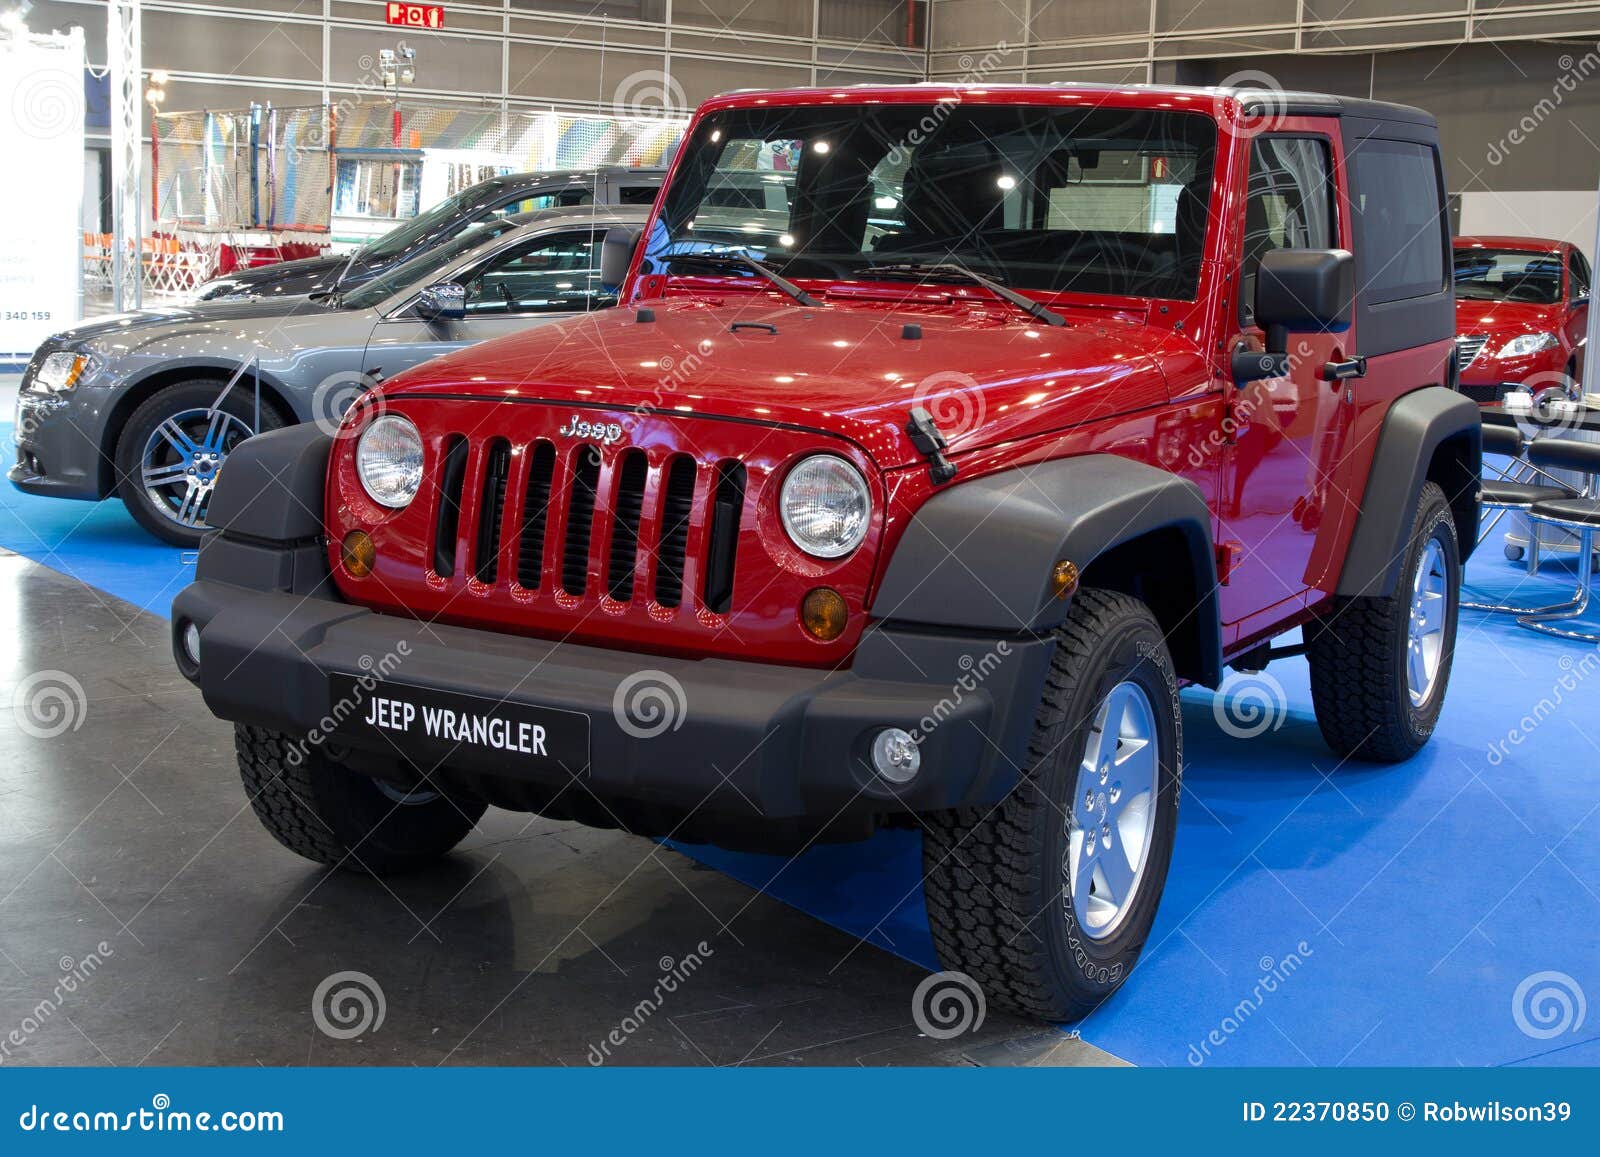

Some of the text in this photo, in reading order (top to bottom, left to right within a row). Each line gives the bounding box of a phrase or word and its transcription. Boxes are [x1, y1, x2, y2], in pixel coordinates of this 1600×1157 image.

[5, 312, 51, 320] 340 159
[560, 415, 622, 446] Jeep
[365, 696, 548, 757] JEEP WRANGLER
[1061, 805, 1123, 984] GOODYEAR
